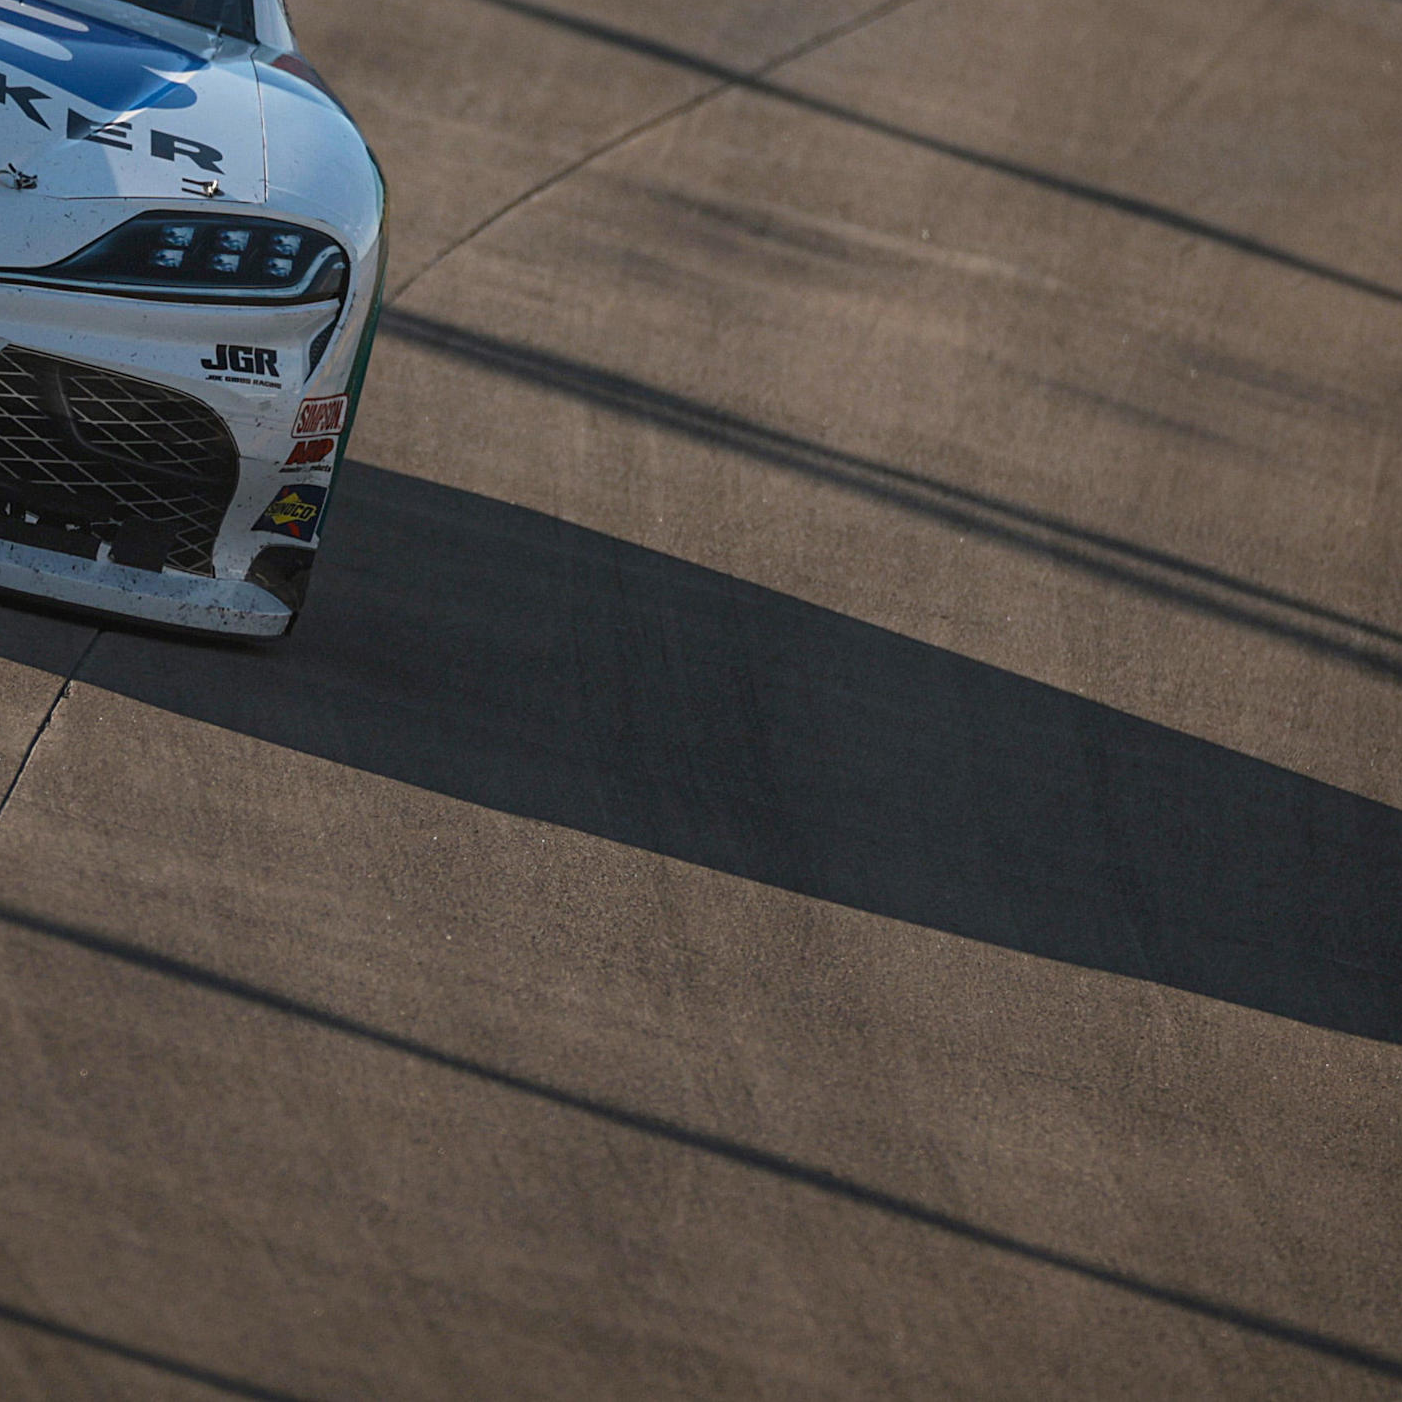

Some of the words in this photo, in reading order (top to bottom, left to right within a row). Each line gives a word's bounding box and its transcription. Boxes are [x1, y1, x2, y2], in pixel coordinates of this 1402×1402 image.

[200, 343, 280, 378] JGR
[253, 378, 282, 390] RACING
[296, 398, 345, 434] SIMPSON
[267, 502, 313, 519] SUNOCO
